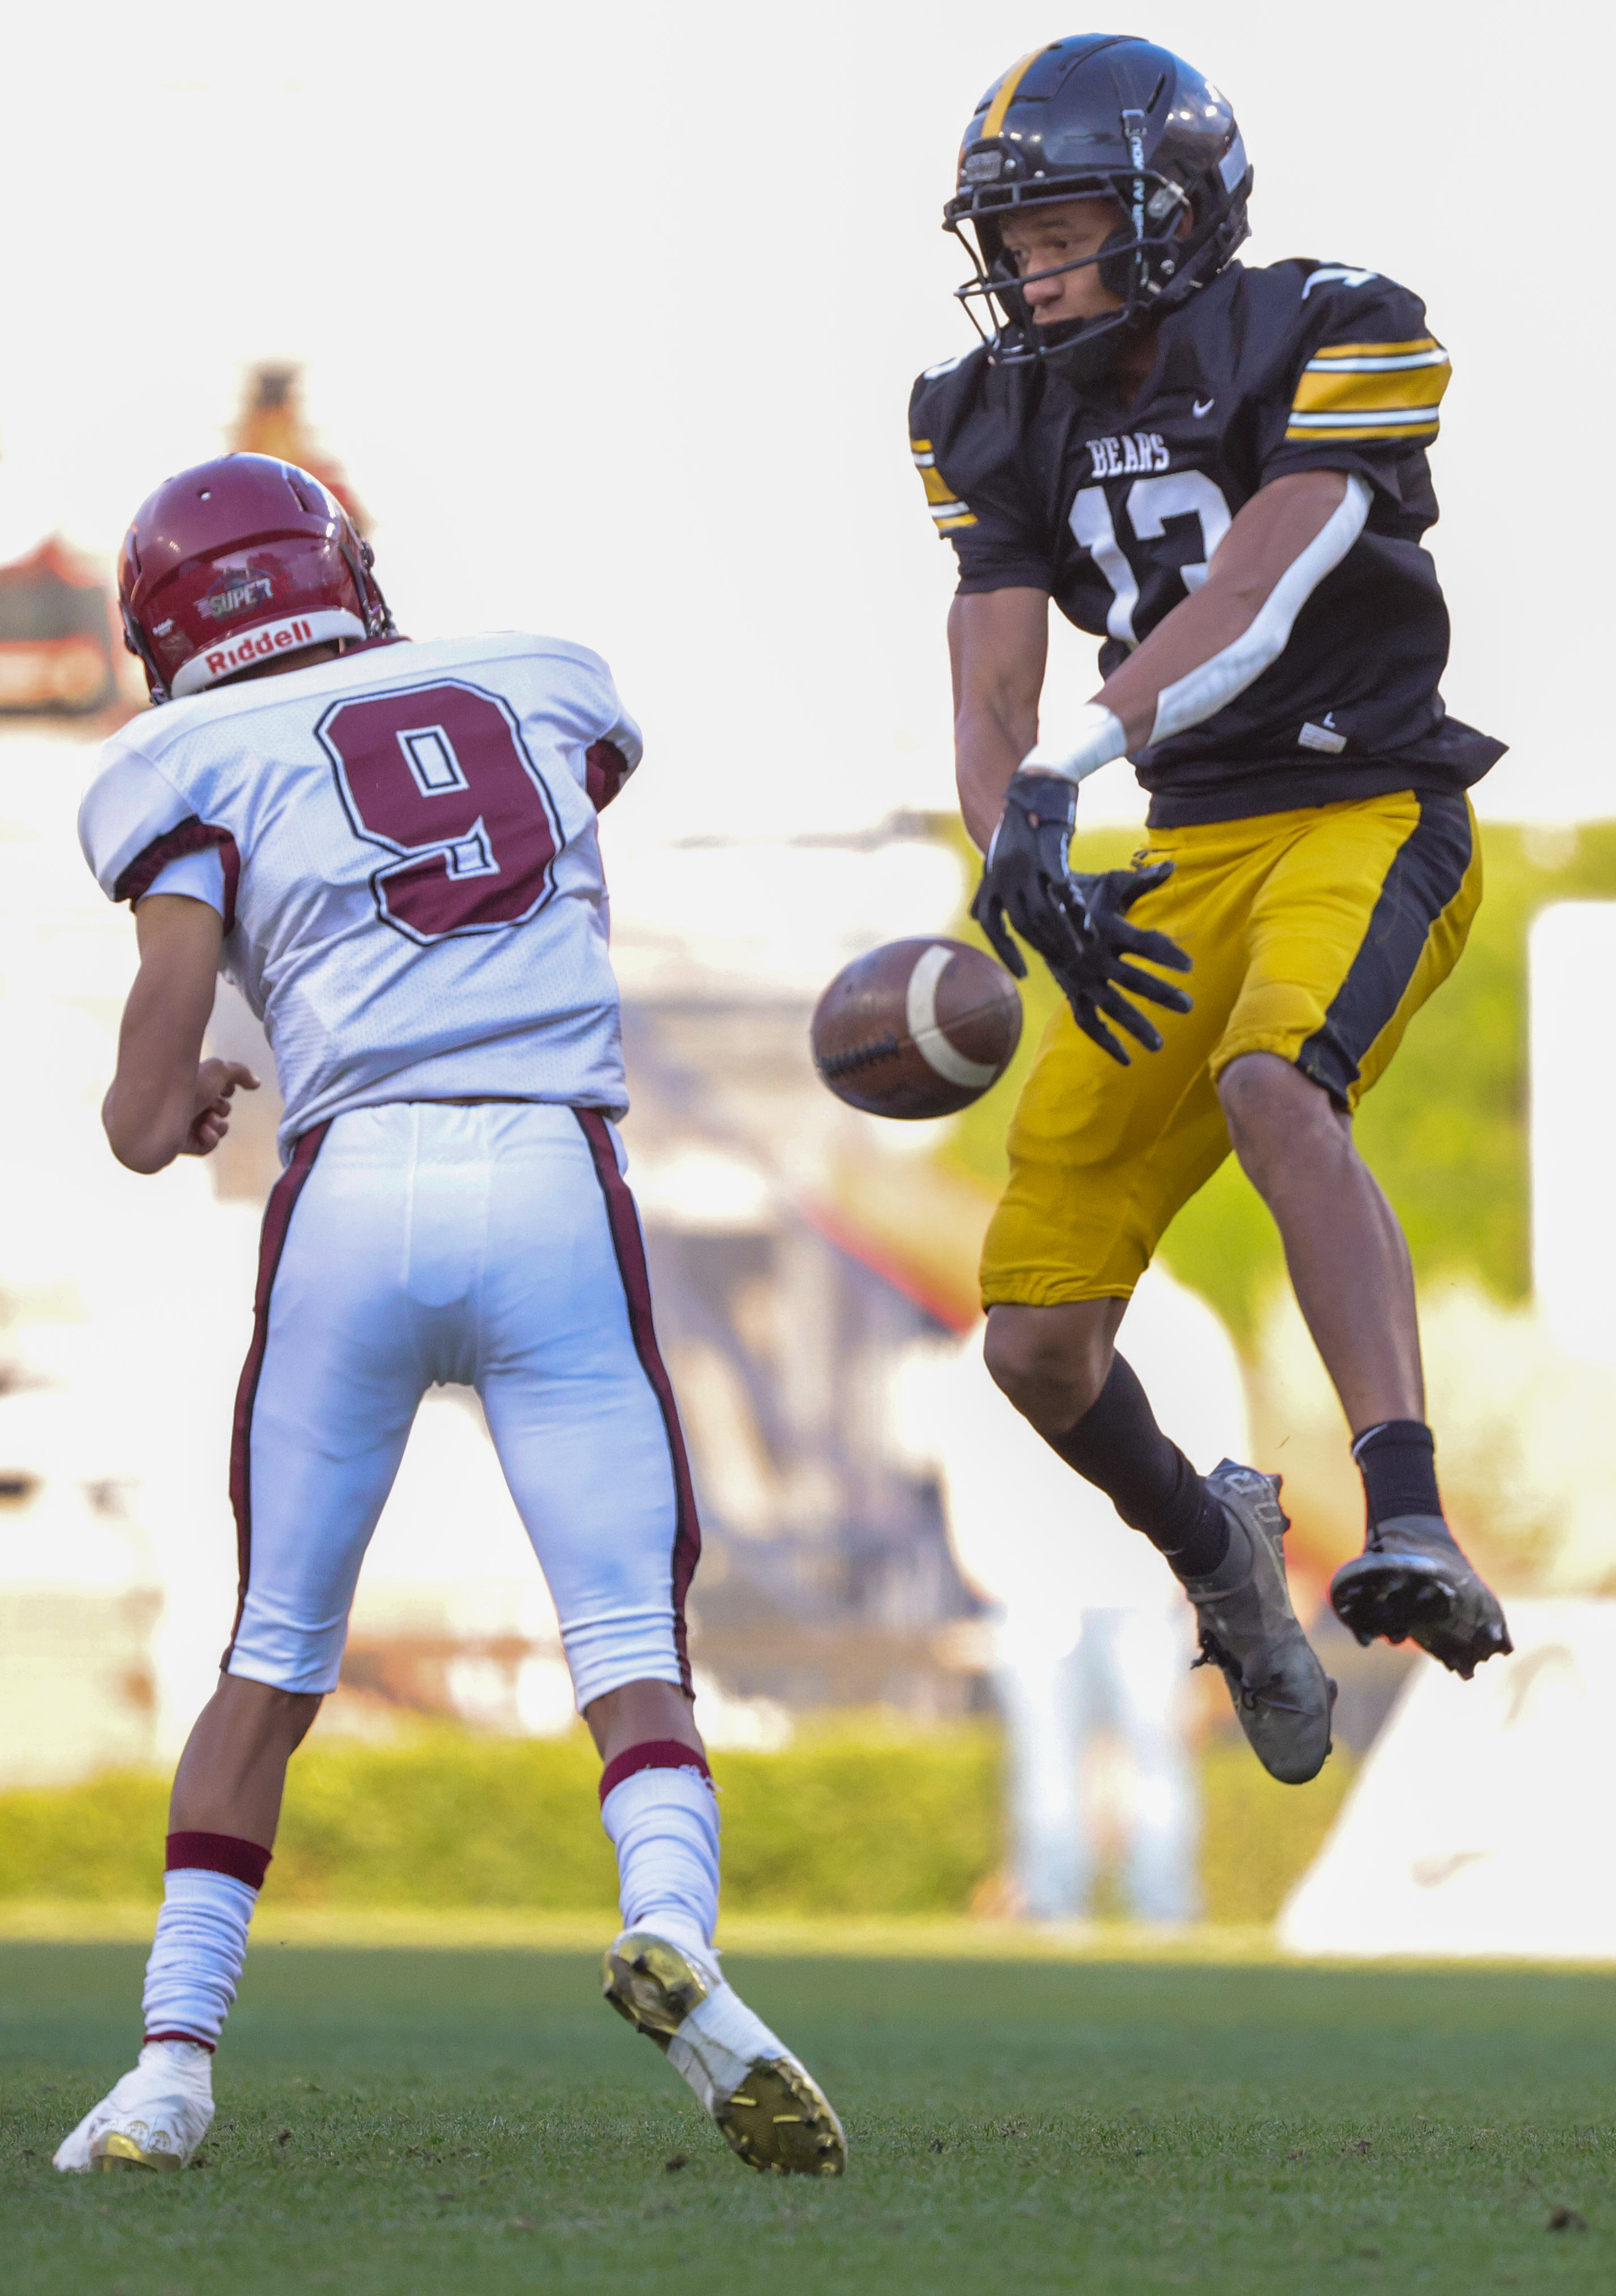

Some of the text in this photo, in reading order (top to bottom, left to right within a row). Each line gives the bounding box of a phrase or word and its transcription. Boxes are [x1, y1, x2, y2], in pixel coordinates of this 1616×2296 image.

[1085, 432, 1170, 479] BEARS
[1067, 469, 1233, 651] 13
[204, 620, 313, 676] Riddell
[313, 677, 566, 948] 9
